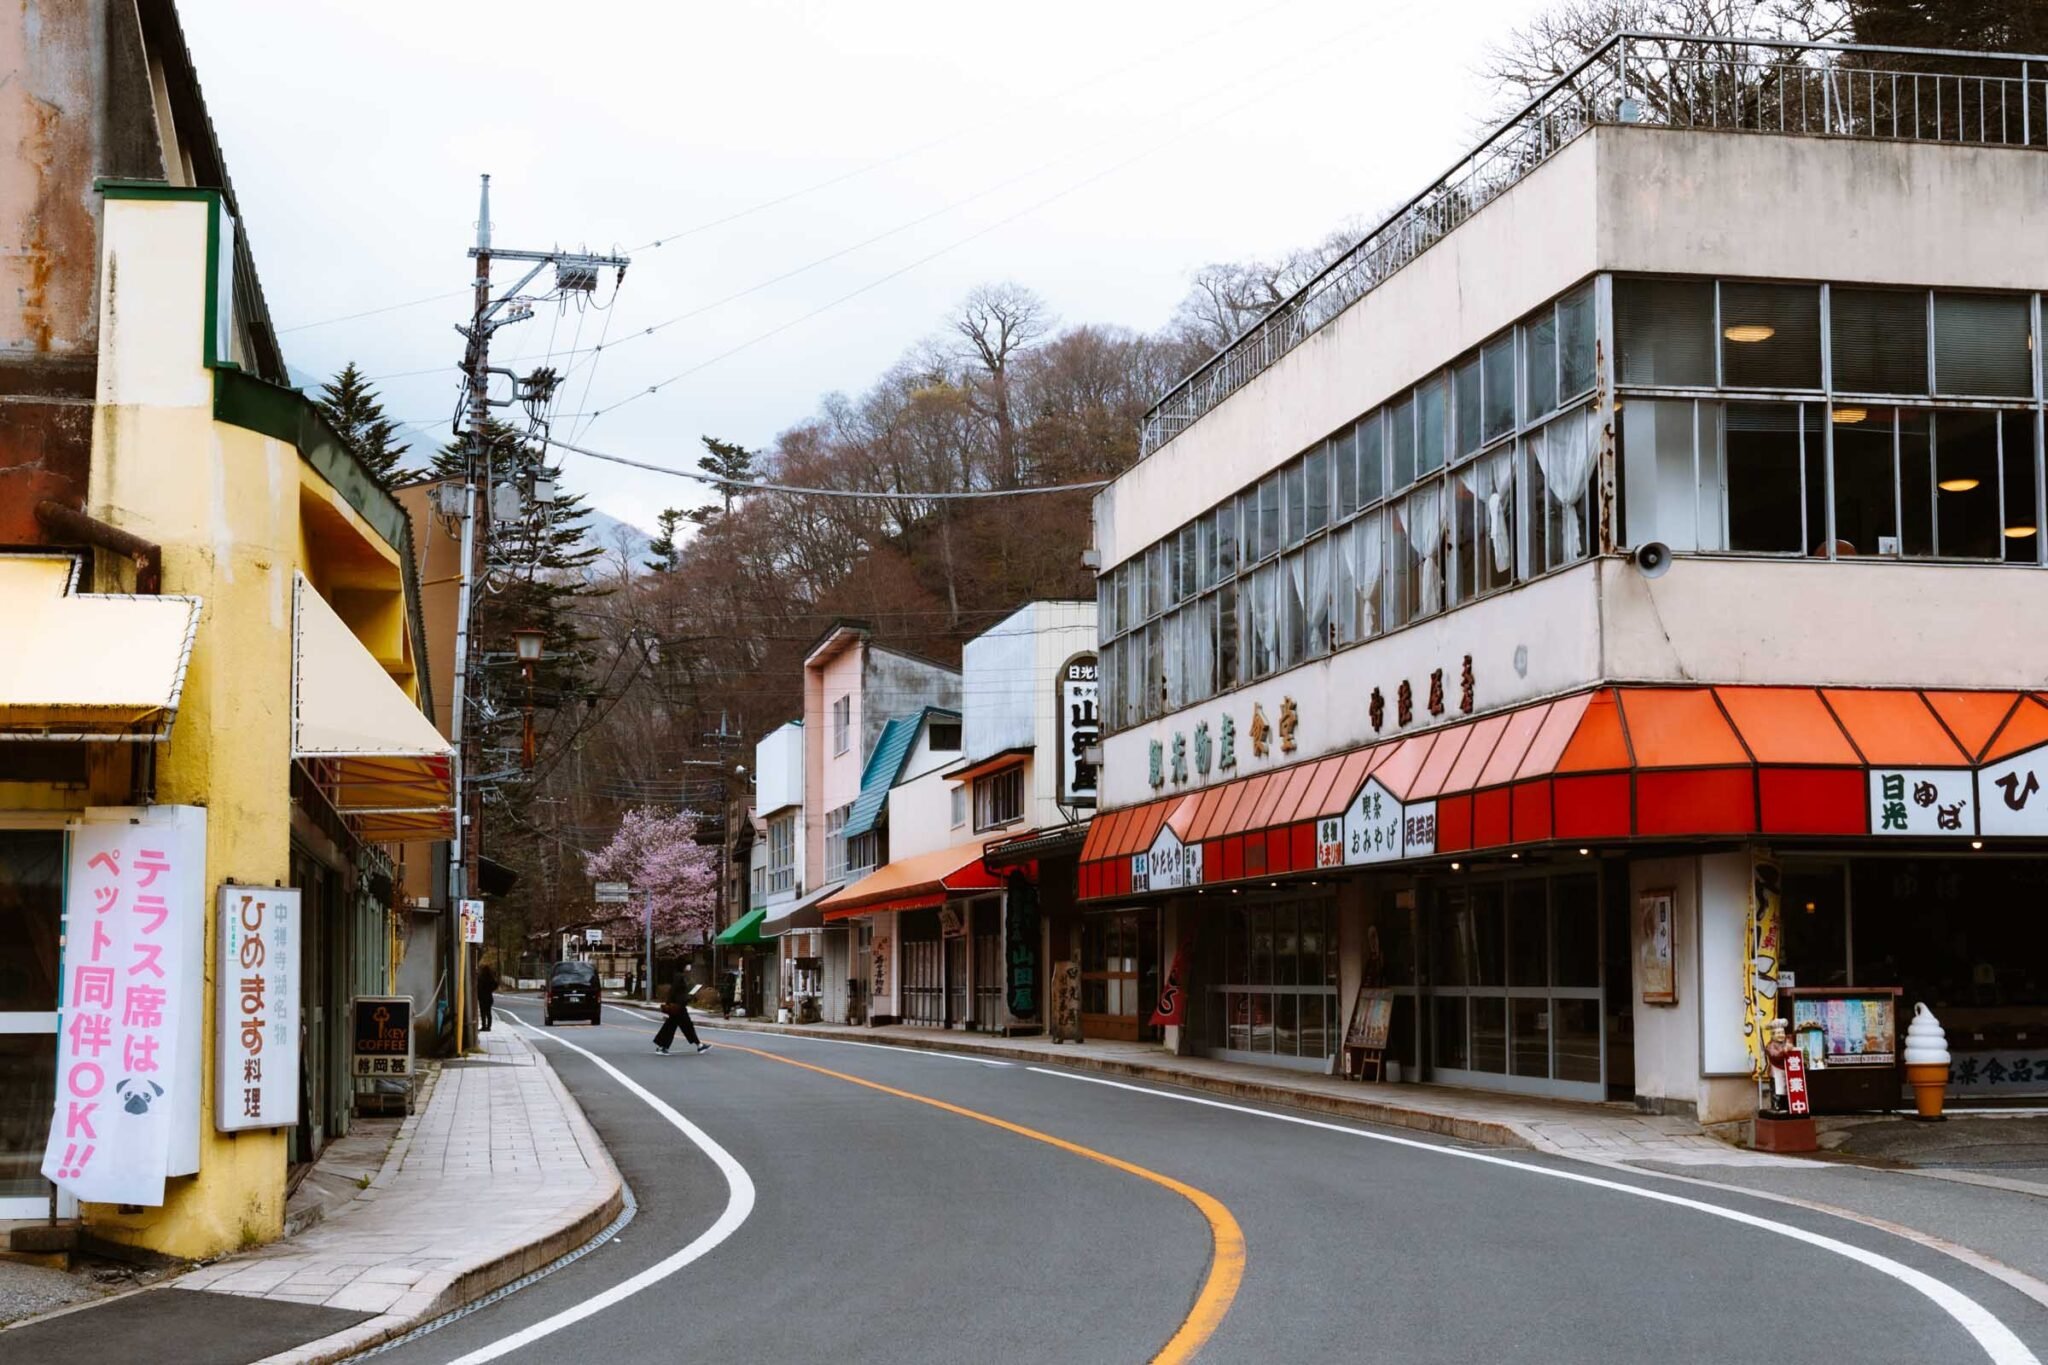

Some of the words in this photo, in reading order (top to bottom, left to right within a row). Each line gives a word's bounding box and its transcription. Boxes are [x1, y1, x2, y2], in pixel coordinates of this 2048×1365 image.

[1069, 665, 1098, 680] 日光
[1362, 792, 1382, 820] 喫茶
[1881, 773, 1909, 830] 日光
[1912, 780, 1967, 831] ゆば
[1351, 817, 1398, 856] おみやげ
[1405, 813, 1435, 847] 民芸品
[122, 849, 171, 1073] テラス席は
[240, 895, 266, 1118] ひめます料理
[357, 1040, 406, 1051] COFFEE
[385, 1028, 407, 1039] KEY
[1787, 1056, 1807, 1115] 営業中
